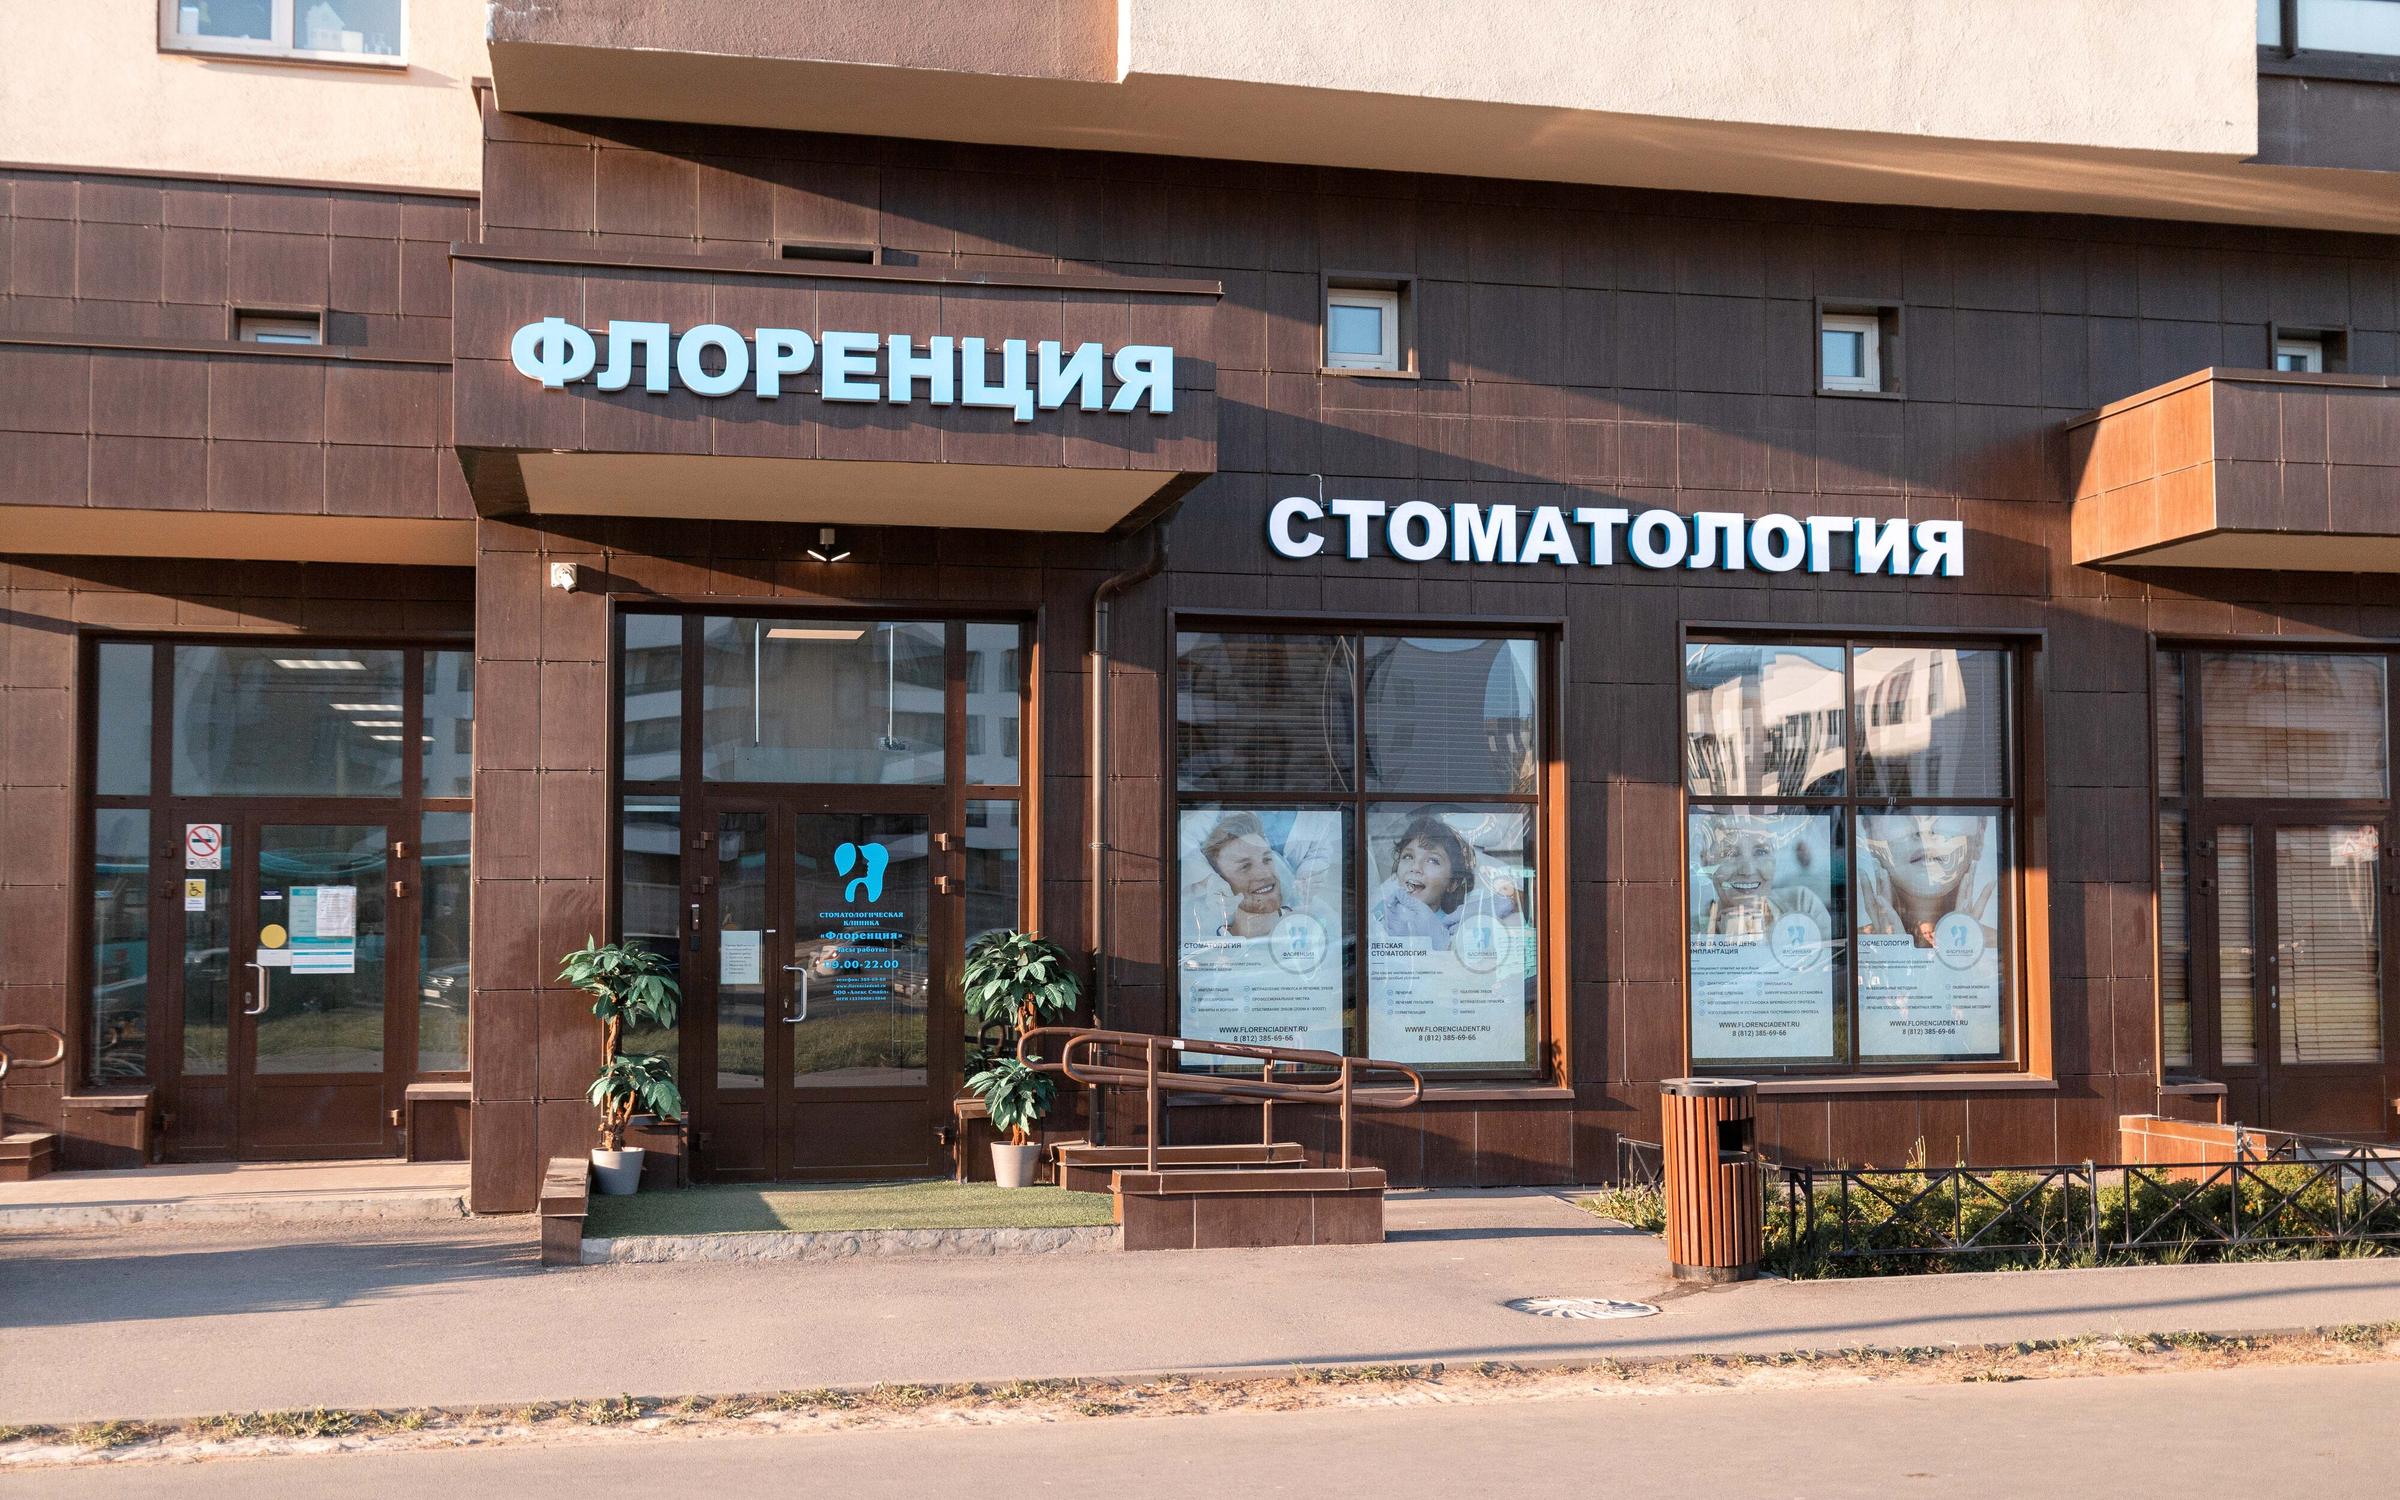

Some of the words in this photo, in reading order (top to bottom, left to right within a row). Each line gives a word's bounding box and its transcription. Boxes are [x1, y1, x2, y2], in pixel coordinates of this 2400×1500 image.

[511, 317, 1174, 423] ФЛОРЕНЦИЯ
[1266, 496, 1965, 578] СТОМАТОЛОГИЯ
[820, 931, 903, 942] «Флоренция»
[1371, 942, 1403, 950] ДЕТСКАЯ
[1219, 1025, 1308, 1033] WWW.FLORENCIADENT.RU
[1404, 1025, 1491, 1033] WWW.FLORENCIADENT.RU
[1907, 1028, 1924, 1036] (812)
[1737, 1030, 1755, 1038] (812)
[1239, 1035, 1258, 1043] (812)
